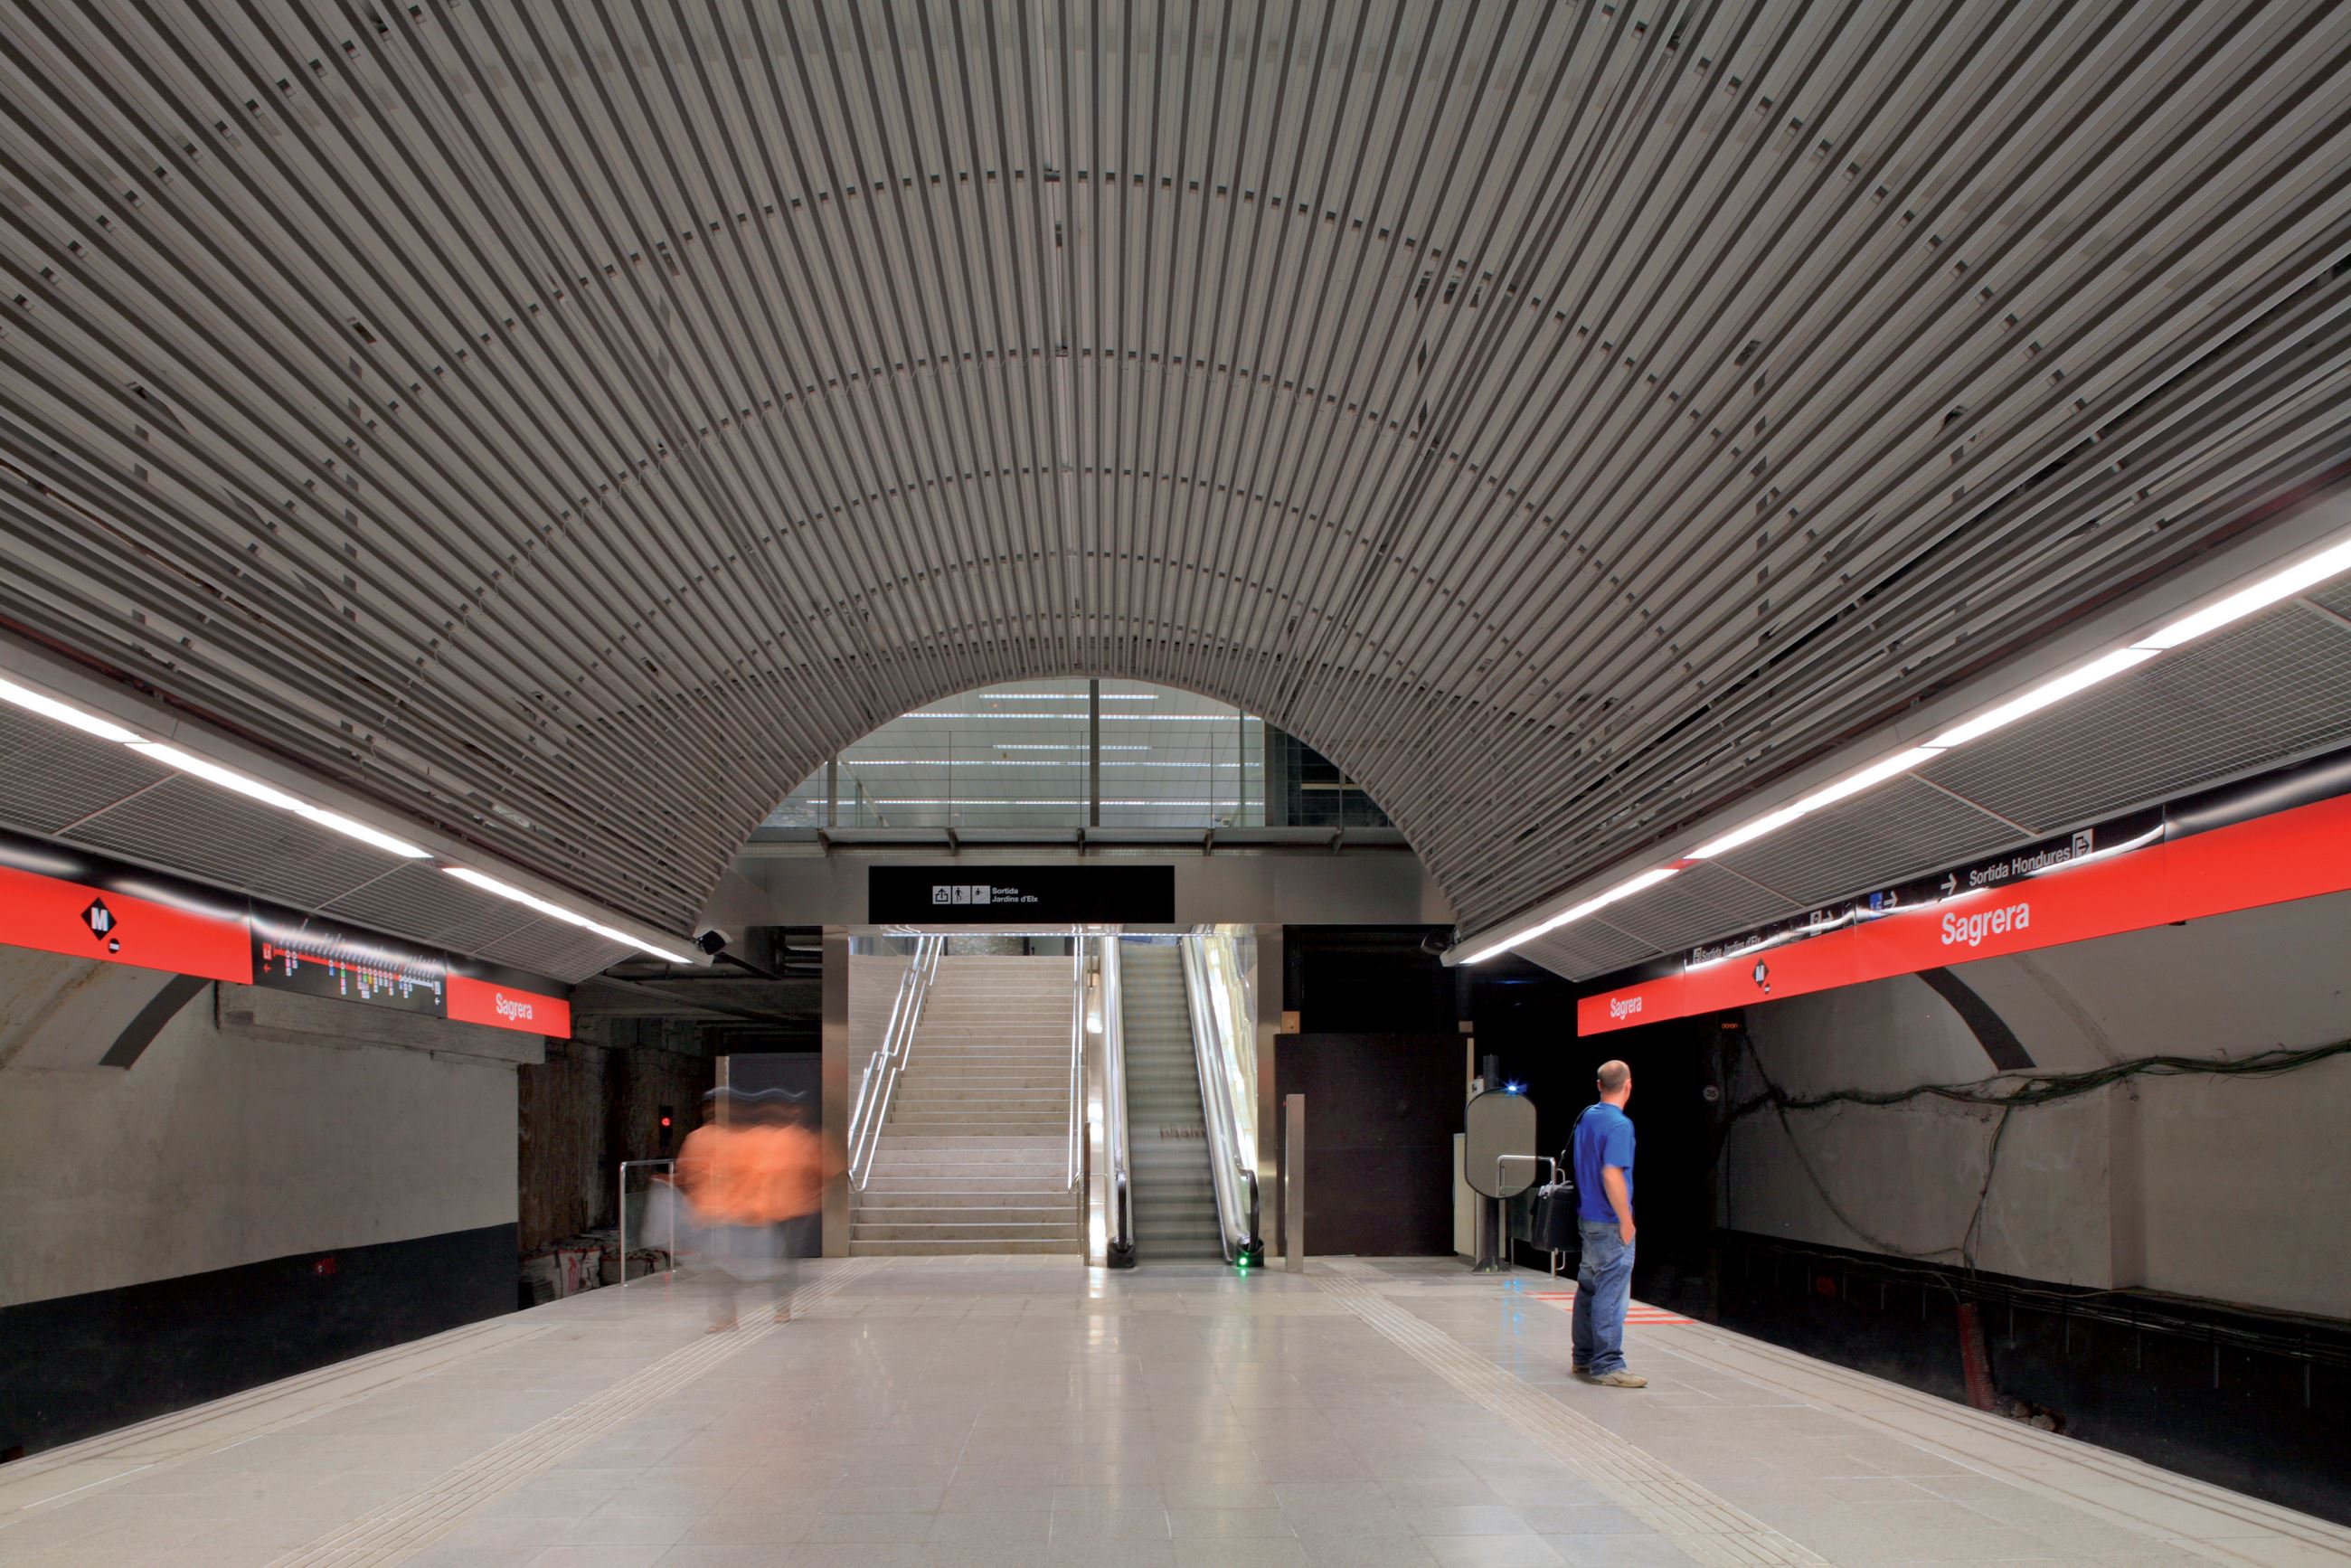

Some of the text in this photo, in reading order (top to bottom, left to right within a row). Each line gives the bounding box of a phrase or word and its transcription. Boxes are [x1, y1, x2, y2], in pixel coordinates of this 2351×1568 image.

[1969, 847, 2071, 886] Sortida Hondures
[91, 907, 109, 931] M
[1941, 902, 2029, 947] Sagrera
[1702, 948, 1722, 963] Sortida
[1756, 965, 1765, 981] M
[496, 993, 533, 1021] Sagrera
[1610, 997, 1642, 1020] Sagrera
